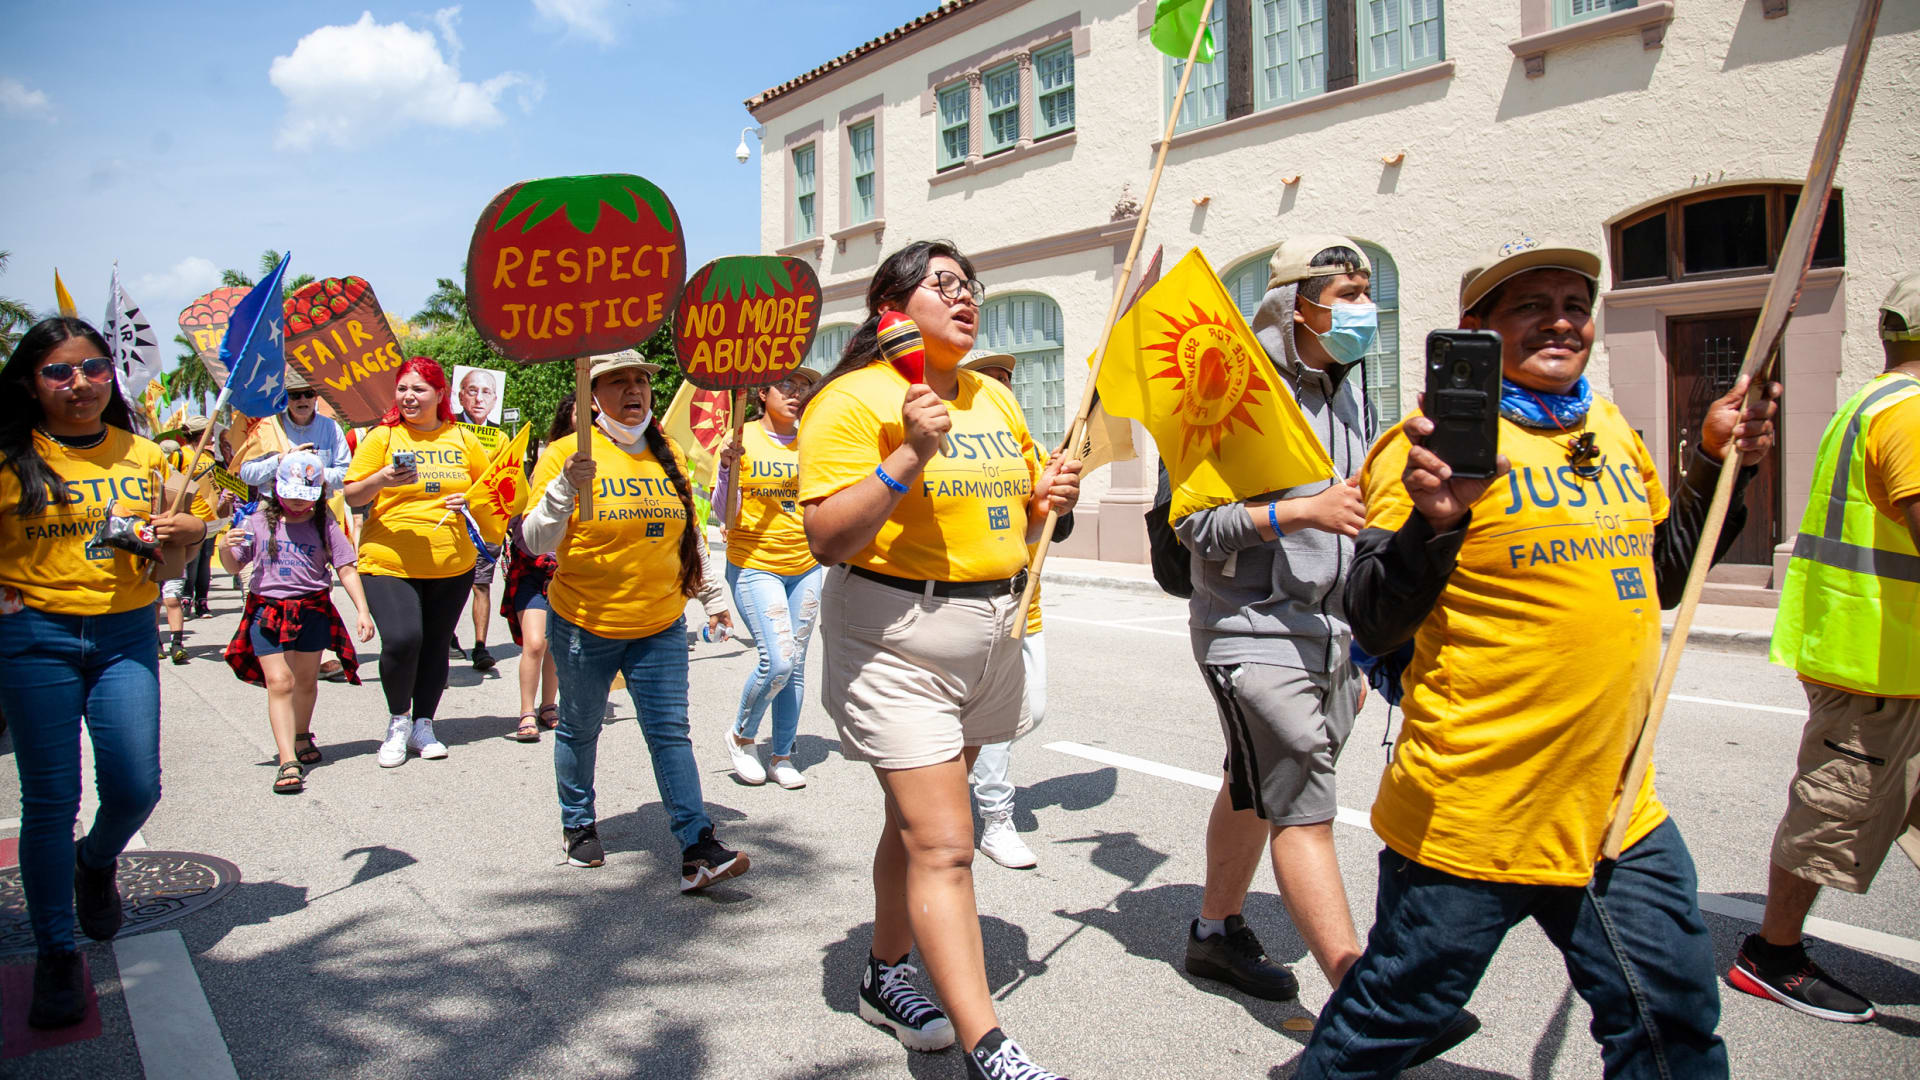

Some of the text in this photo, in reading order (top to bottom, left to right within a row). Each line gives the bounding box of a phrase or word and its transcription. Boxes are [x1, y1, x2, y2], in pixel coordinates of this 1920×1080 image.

[493, 244, 677, 289] RESPECT
[500, 292, 664, 339] JUSTICE
[683, 295, 815, 338] NO MORE
[292, 319, 374, 373] FAIR
[687, 334, 806, 374] ABUSES
[324, 341, 402, 391] WAGES
[397, 449, 464, 465] STICE
[938, 431, 1023, 461] USTICE
[982, 463, 1000, 478] for
[46, 476, 150, 506] STICE
[644, 497, 660, 507] for
[1594, 510, 1620, 530] for
